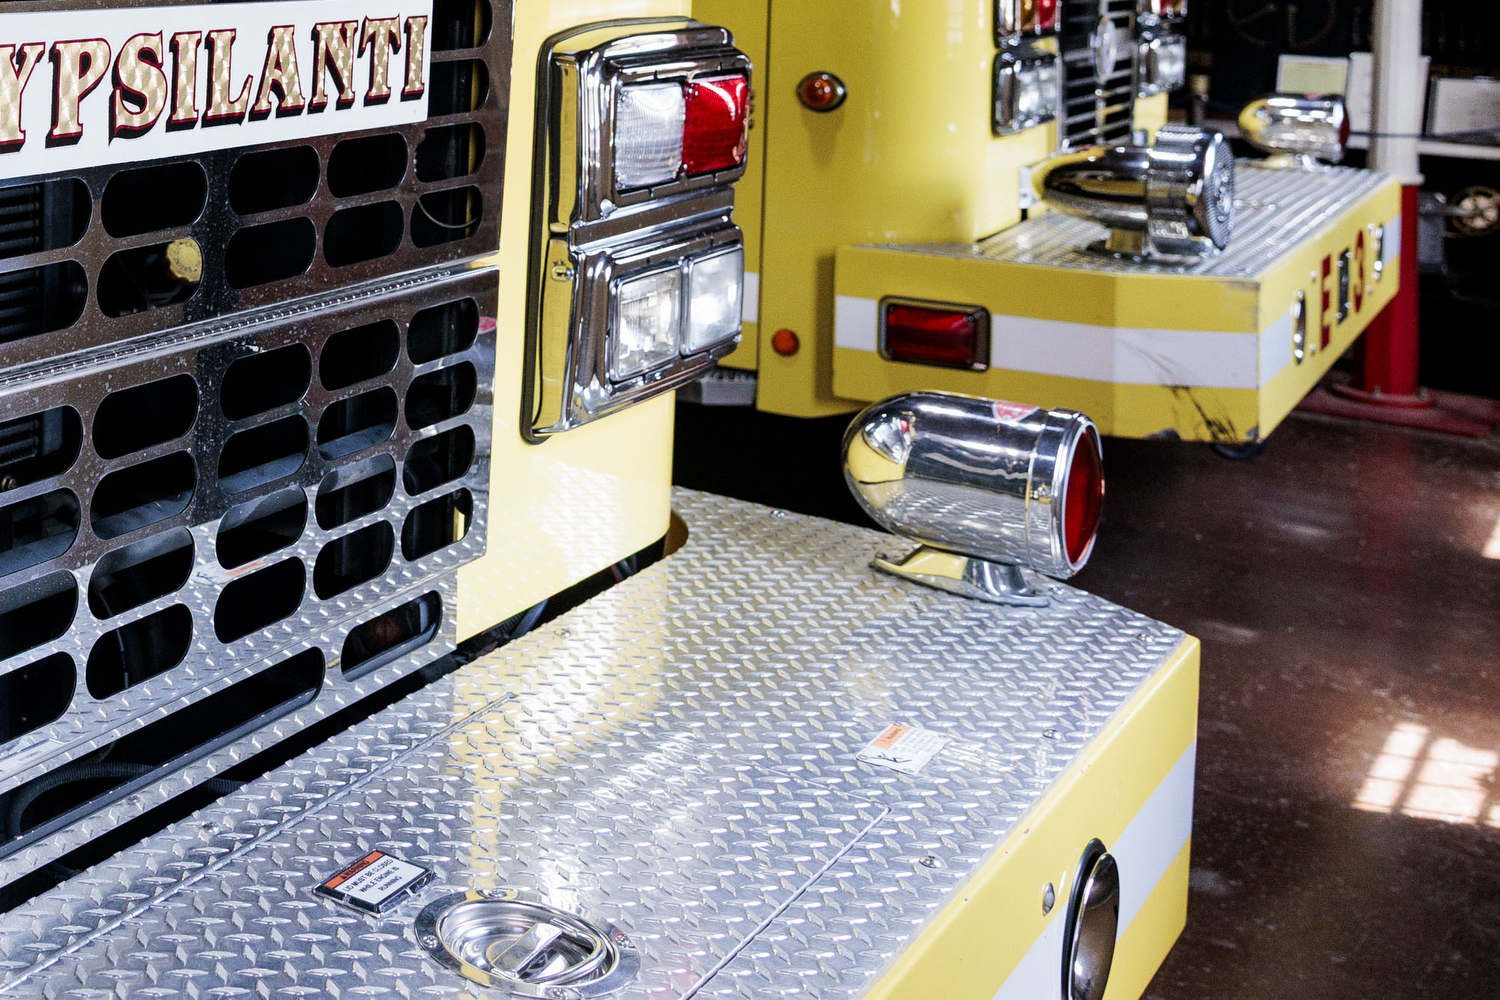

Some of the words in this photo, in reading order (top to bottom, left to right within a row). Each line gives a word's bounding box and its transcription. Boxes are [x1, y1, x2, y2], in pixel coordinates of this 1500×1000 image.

[342, 884, 354, 892] LID
[351, 875, 367, 886] MUST
[372, 859, 394, 872] CLOSED
[344, 860, 370, 876] WARNING
[359, 881, 377, 892] WHILE
[374, 869, 395, 882] ENGINE
[377, 875, 402, 891] RUNNING
